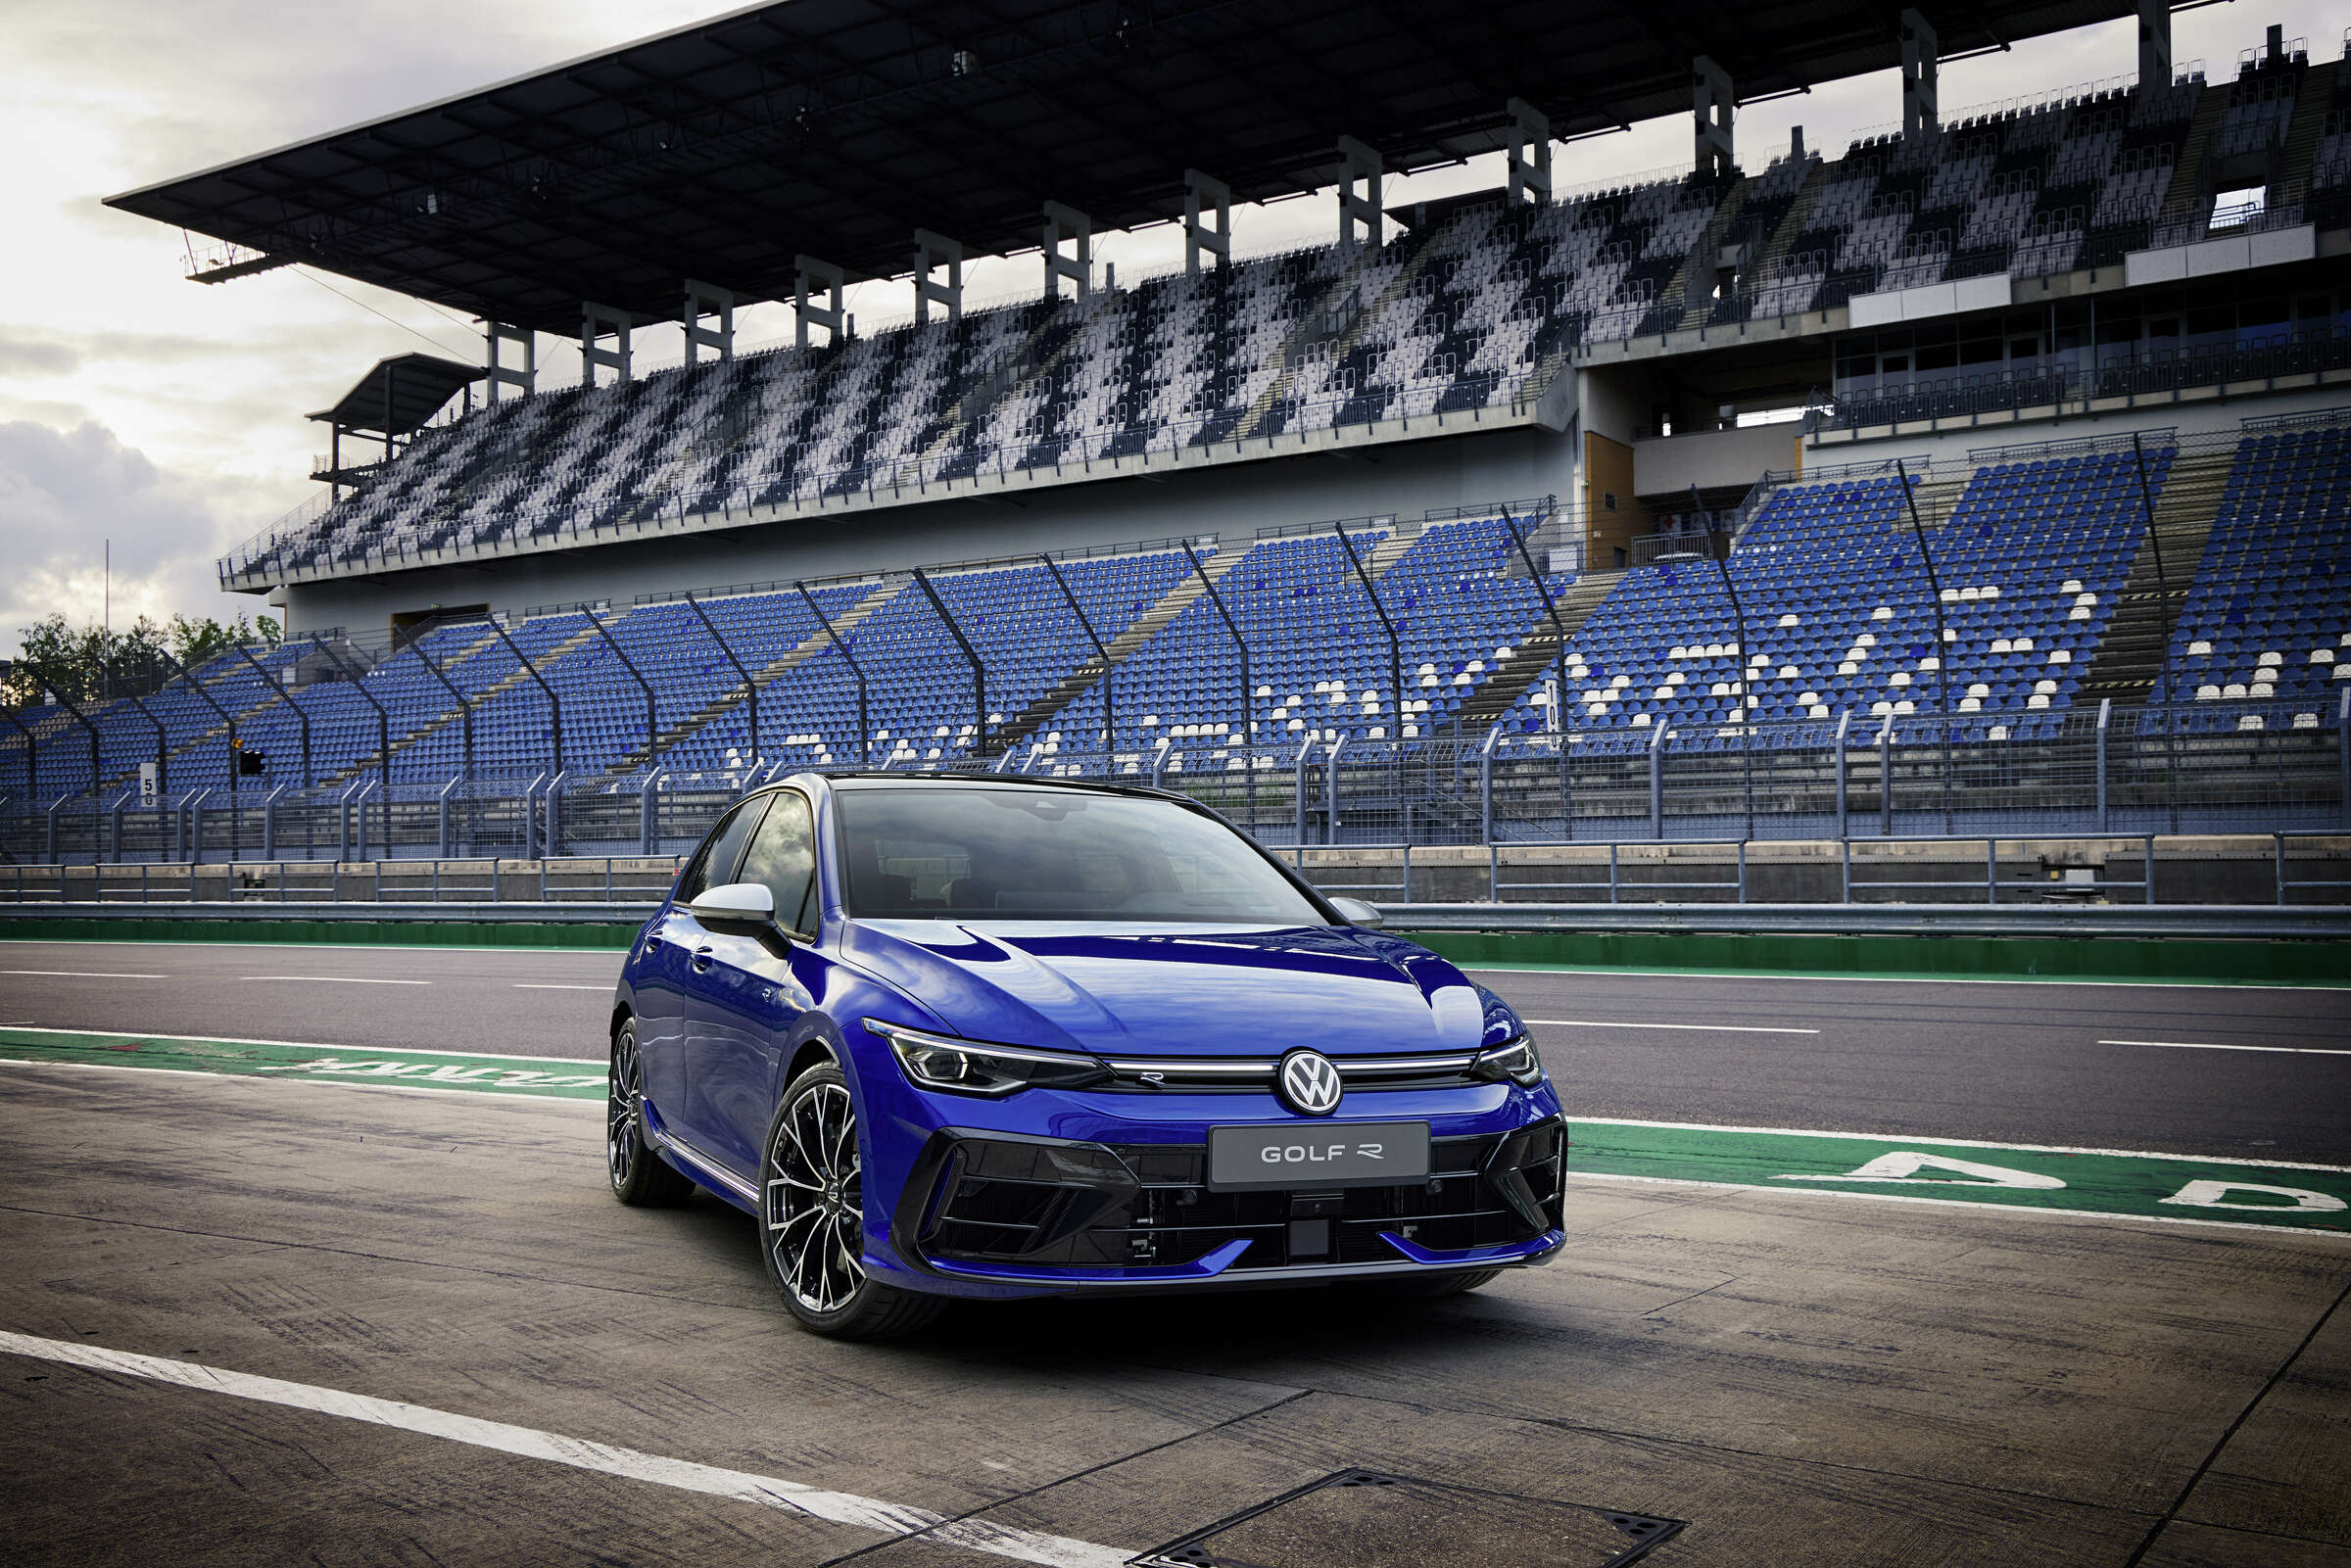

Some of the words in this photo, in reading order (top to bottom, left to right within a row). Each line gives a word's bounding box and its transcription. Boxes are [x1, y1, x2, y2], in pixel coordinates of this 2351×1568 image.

[1283, 1053, 1341, 1112] VW
[1261, 1144, 1346, 1164] GOLF
[1356, 1143, 1385, 1160] R
